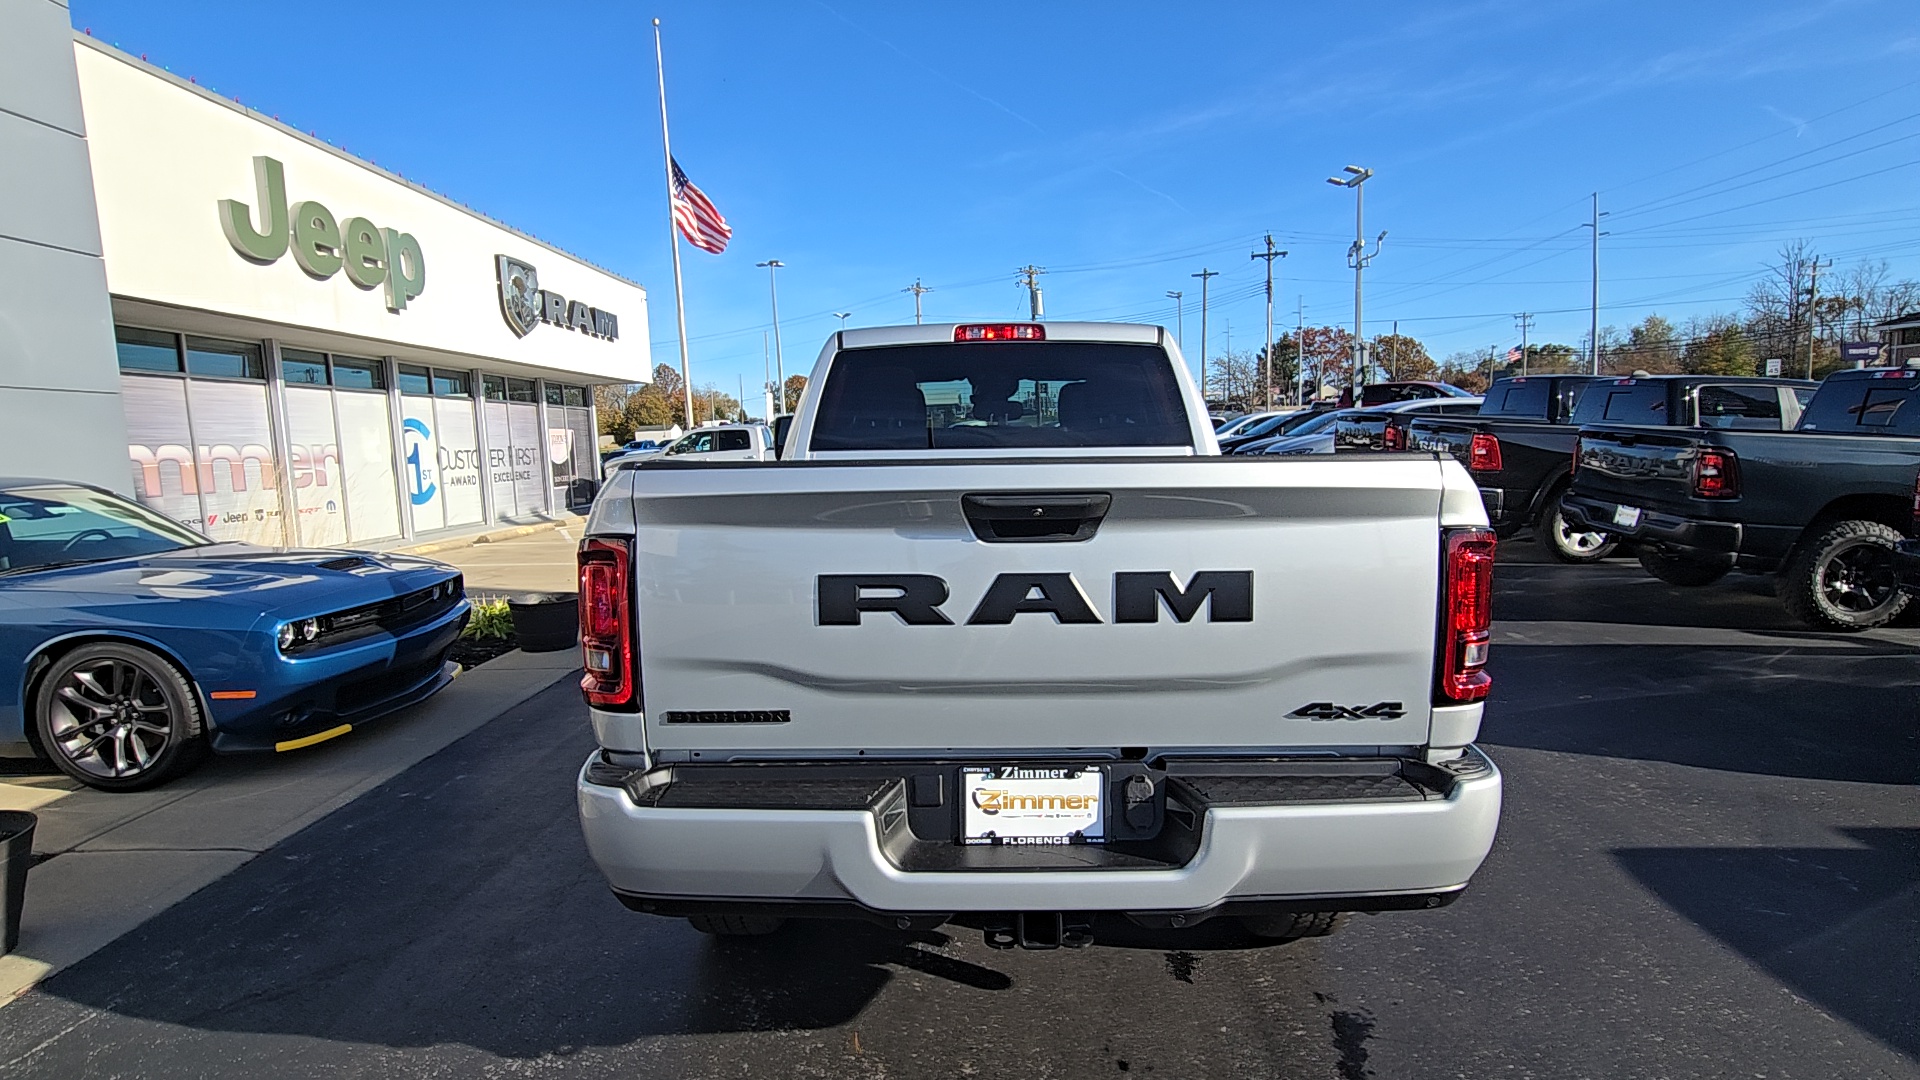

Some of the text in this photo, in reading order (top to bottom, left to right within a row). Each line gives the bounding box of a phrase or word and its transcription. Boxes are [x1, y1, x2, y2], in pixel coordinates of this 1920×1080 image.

[218, 156, 426, 313] Jeep
[541, 289, 619, 341] RAM
[436, 445, 507, 472] CUSTOER
[450, 470, 531, 486] AWARD EXCELENCE
[223, 511, 249, 525] Jeep
[816, 569, 1255, 627] RAM
[1001, 766, 1069, 779] Zimmer
[979, 789, 1098, 811] Zimmer
[1003, 836, 1070, 845] FLORENCE
